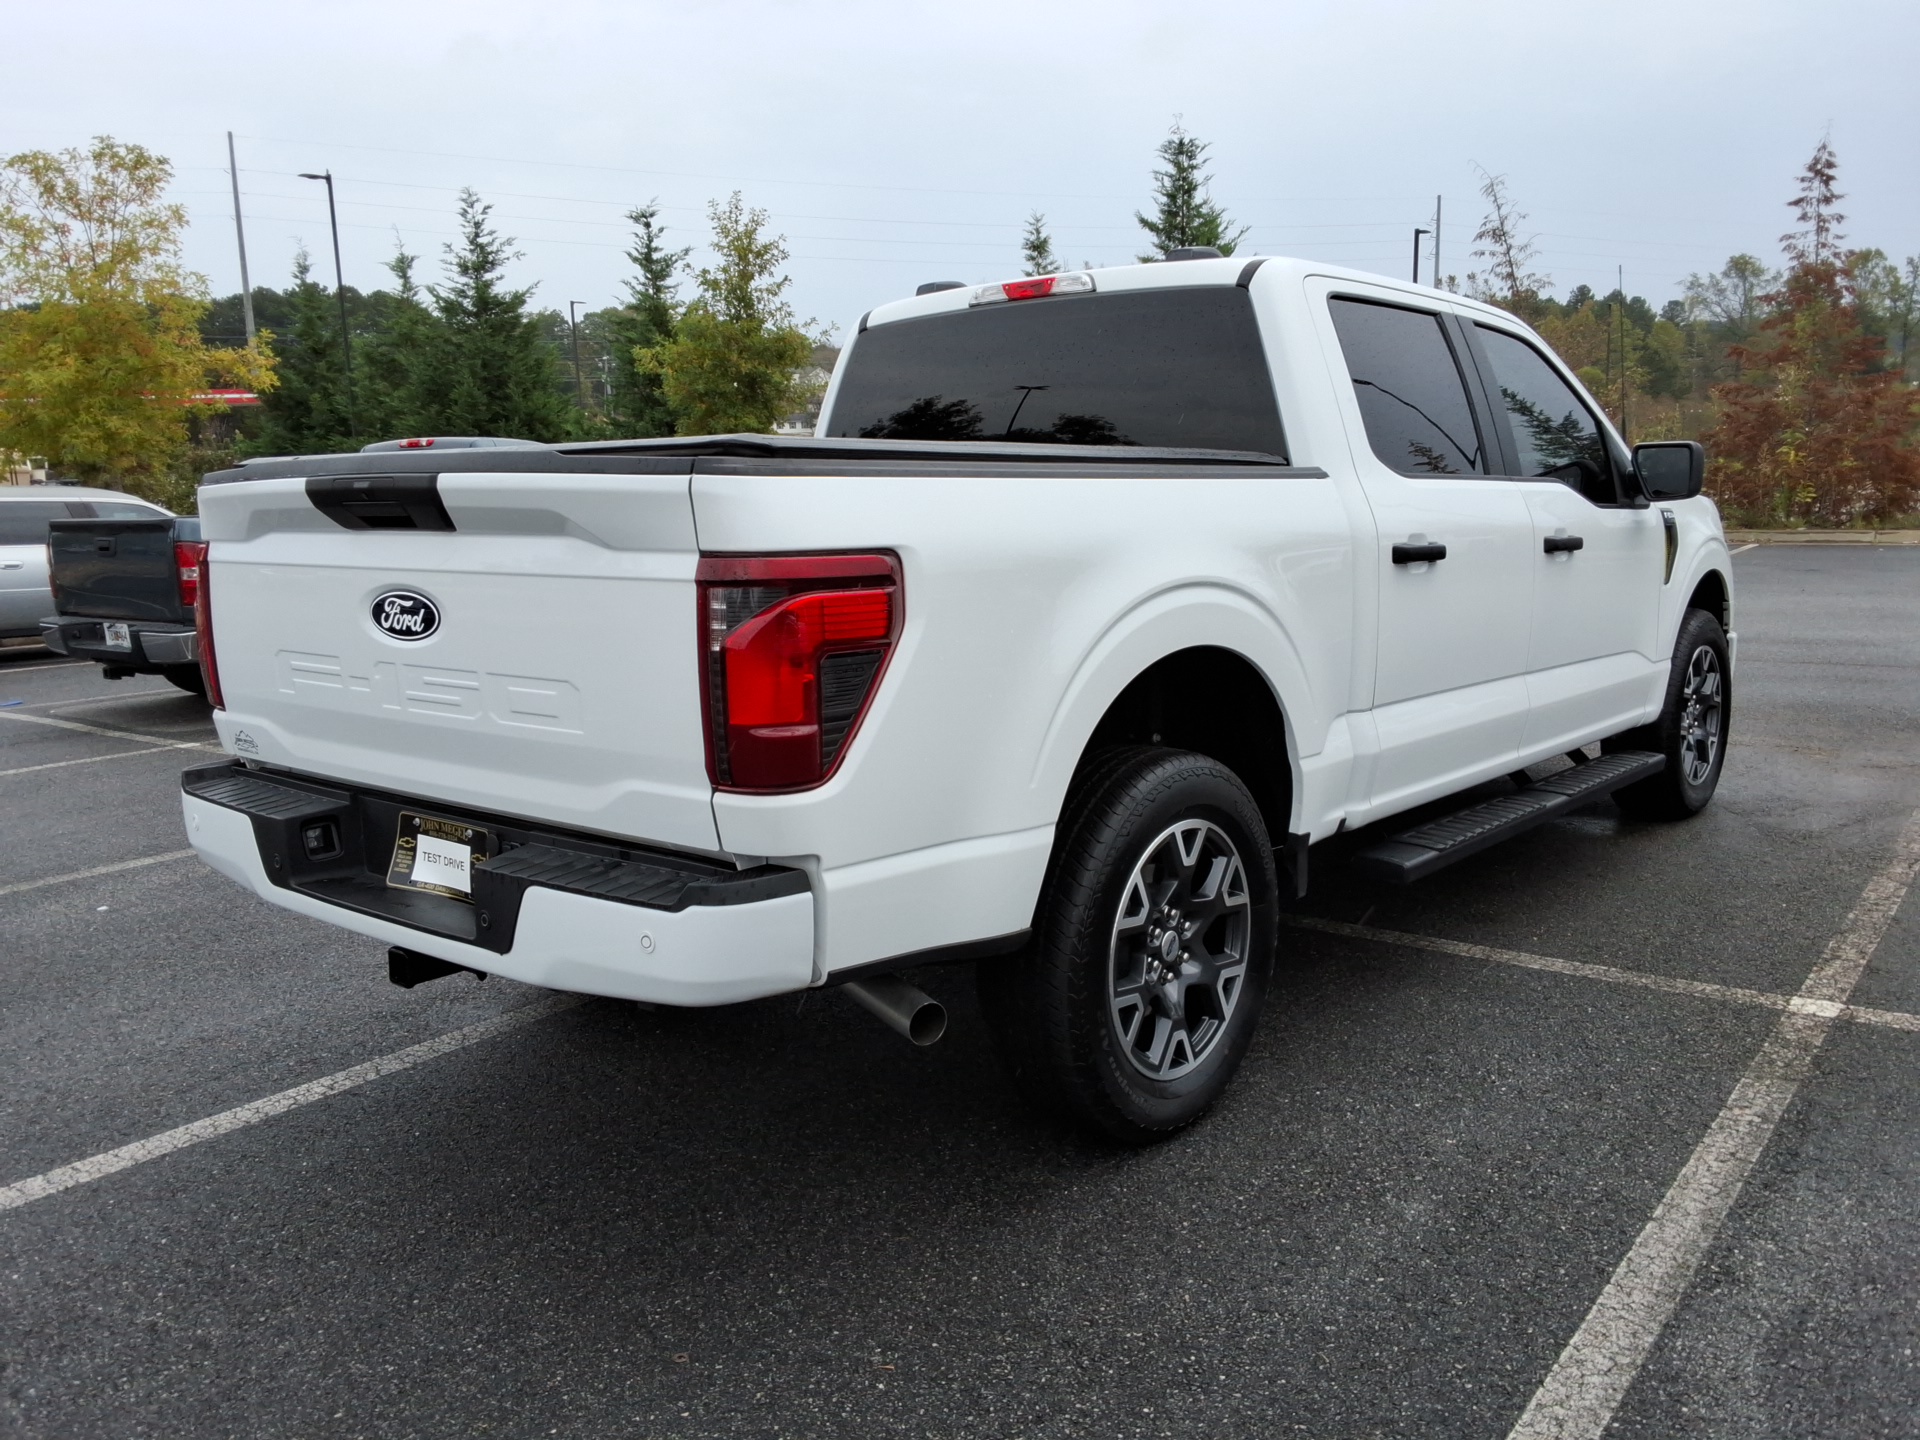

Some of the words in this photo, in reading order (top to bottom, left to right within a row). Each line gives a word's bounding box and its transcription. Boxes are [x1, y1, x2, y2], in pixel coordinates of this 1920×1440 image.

[381, 597, 425, 632] Ford
[419, 818, 440, 832] JOHN
[422, 851, 442, 865] TEST
[443, 856, 465, 871] DRIVE
